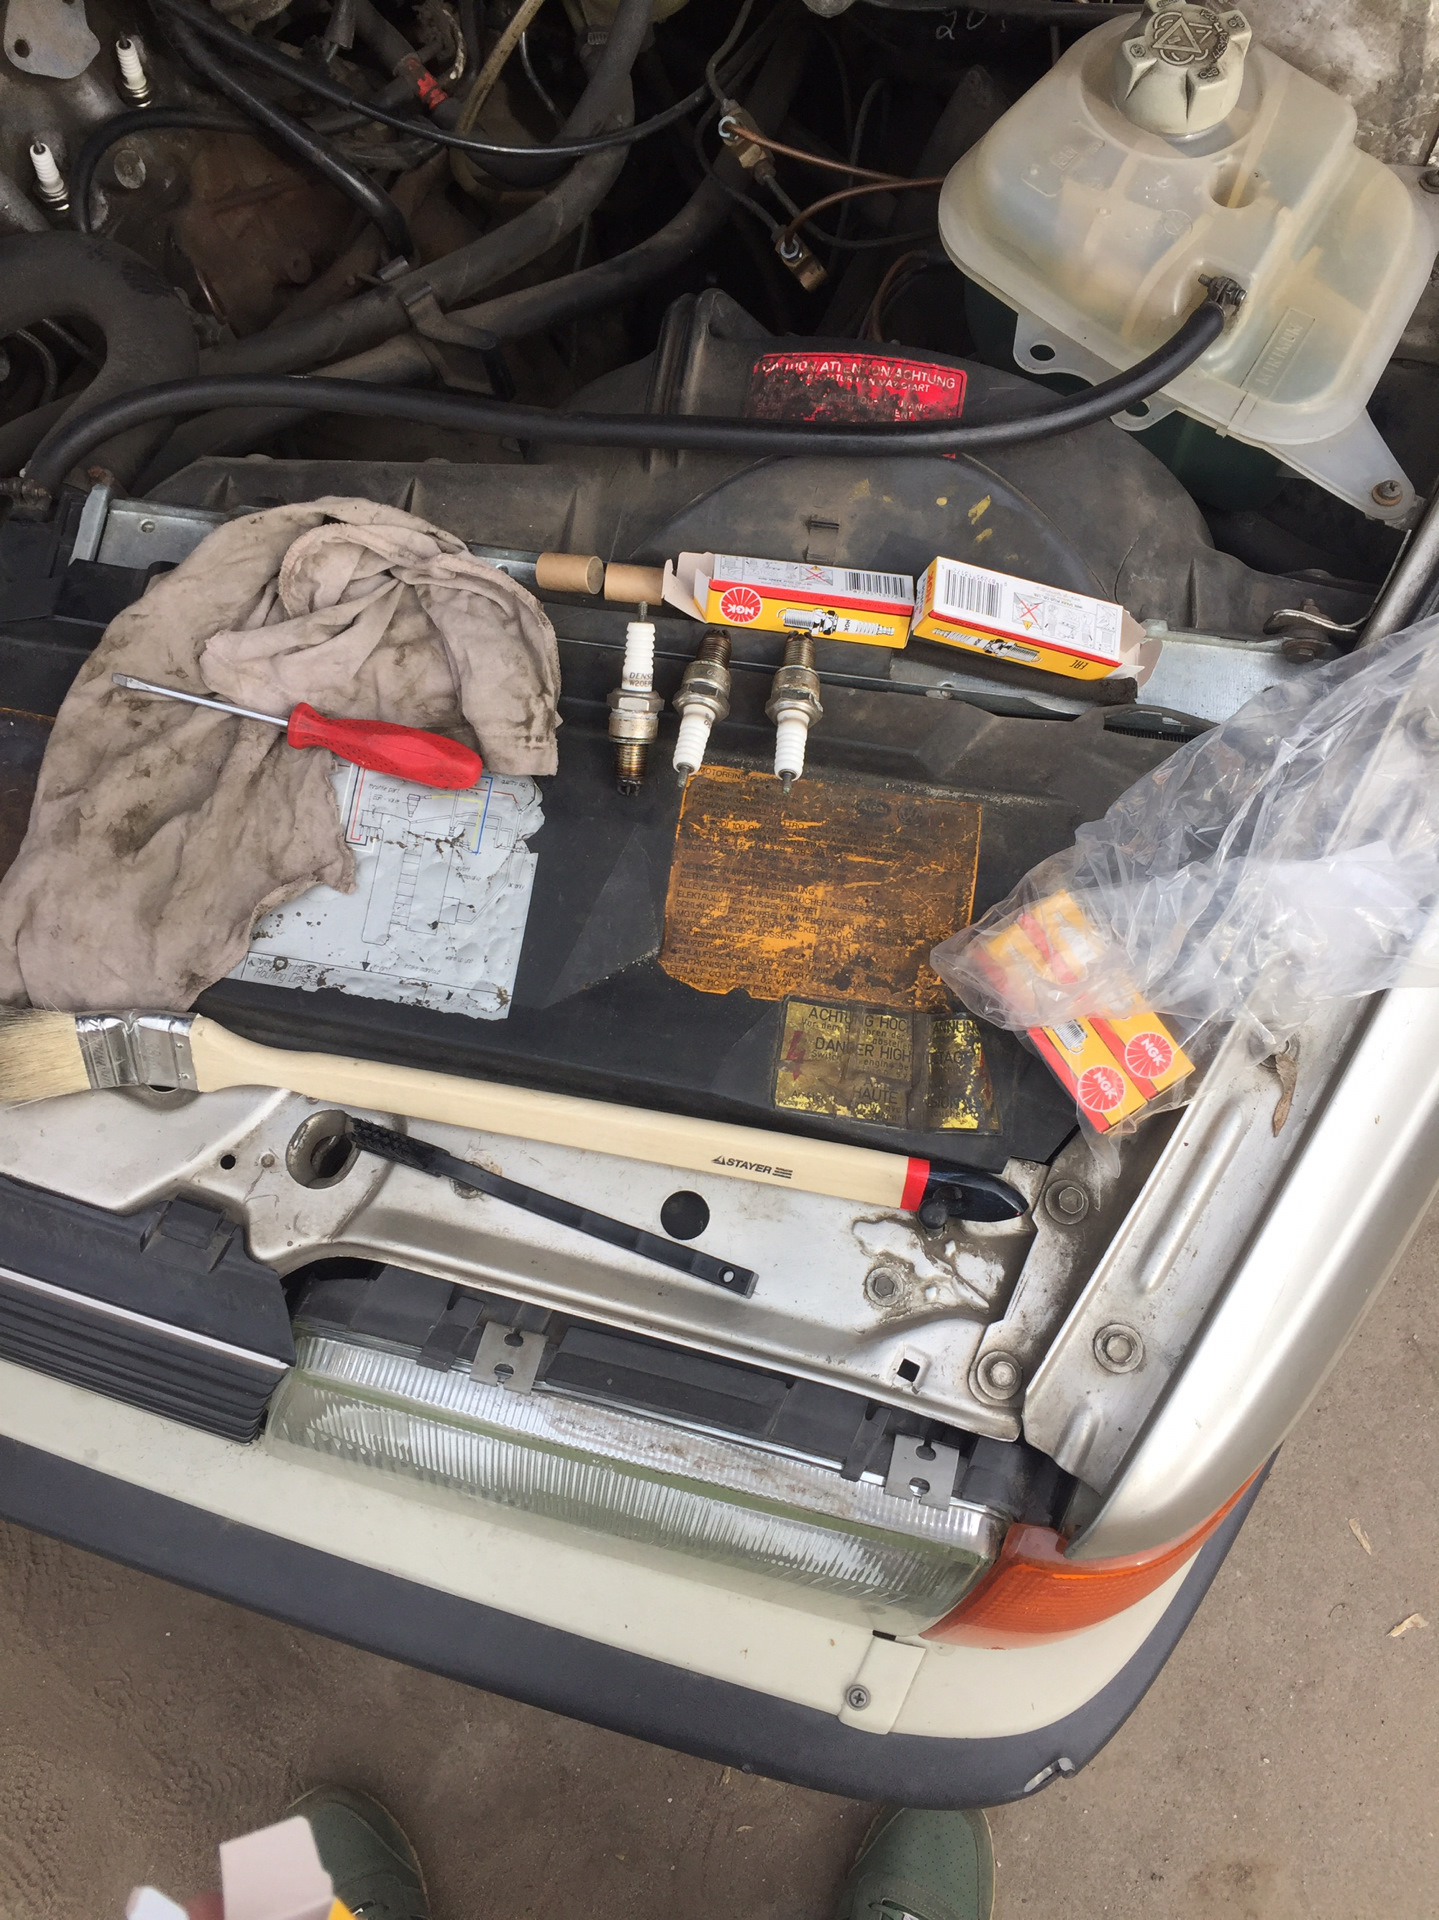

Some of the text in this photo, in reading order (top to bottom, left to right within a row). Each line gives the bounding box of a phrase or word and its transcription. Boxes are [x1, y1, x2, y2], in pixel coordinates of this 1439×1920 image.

[727, 603, 755, 615] NGK
[809, 1007, 874, 1027] ACHTUG
[815, 1036, 874, 1057] DANER
[880, 1046, 912, 1063] HIGH
[1140, 1038, 1166, 1067] NGK
[1093, 1071, 1118, 1100] NGK
[726, 1158, 772, 1174] STAYER
